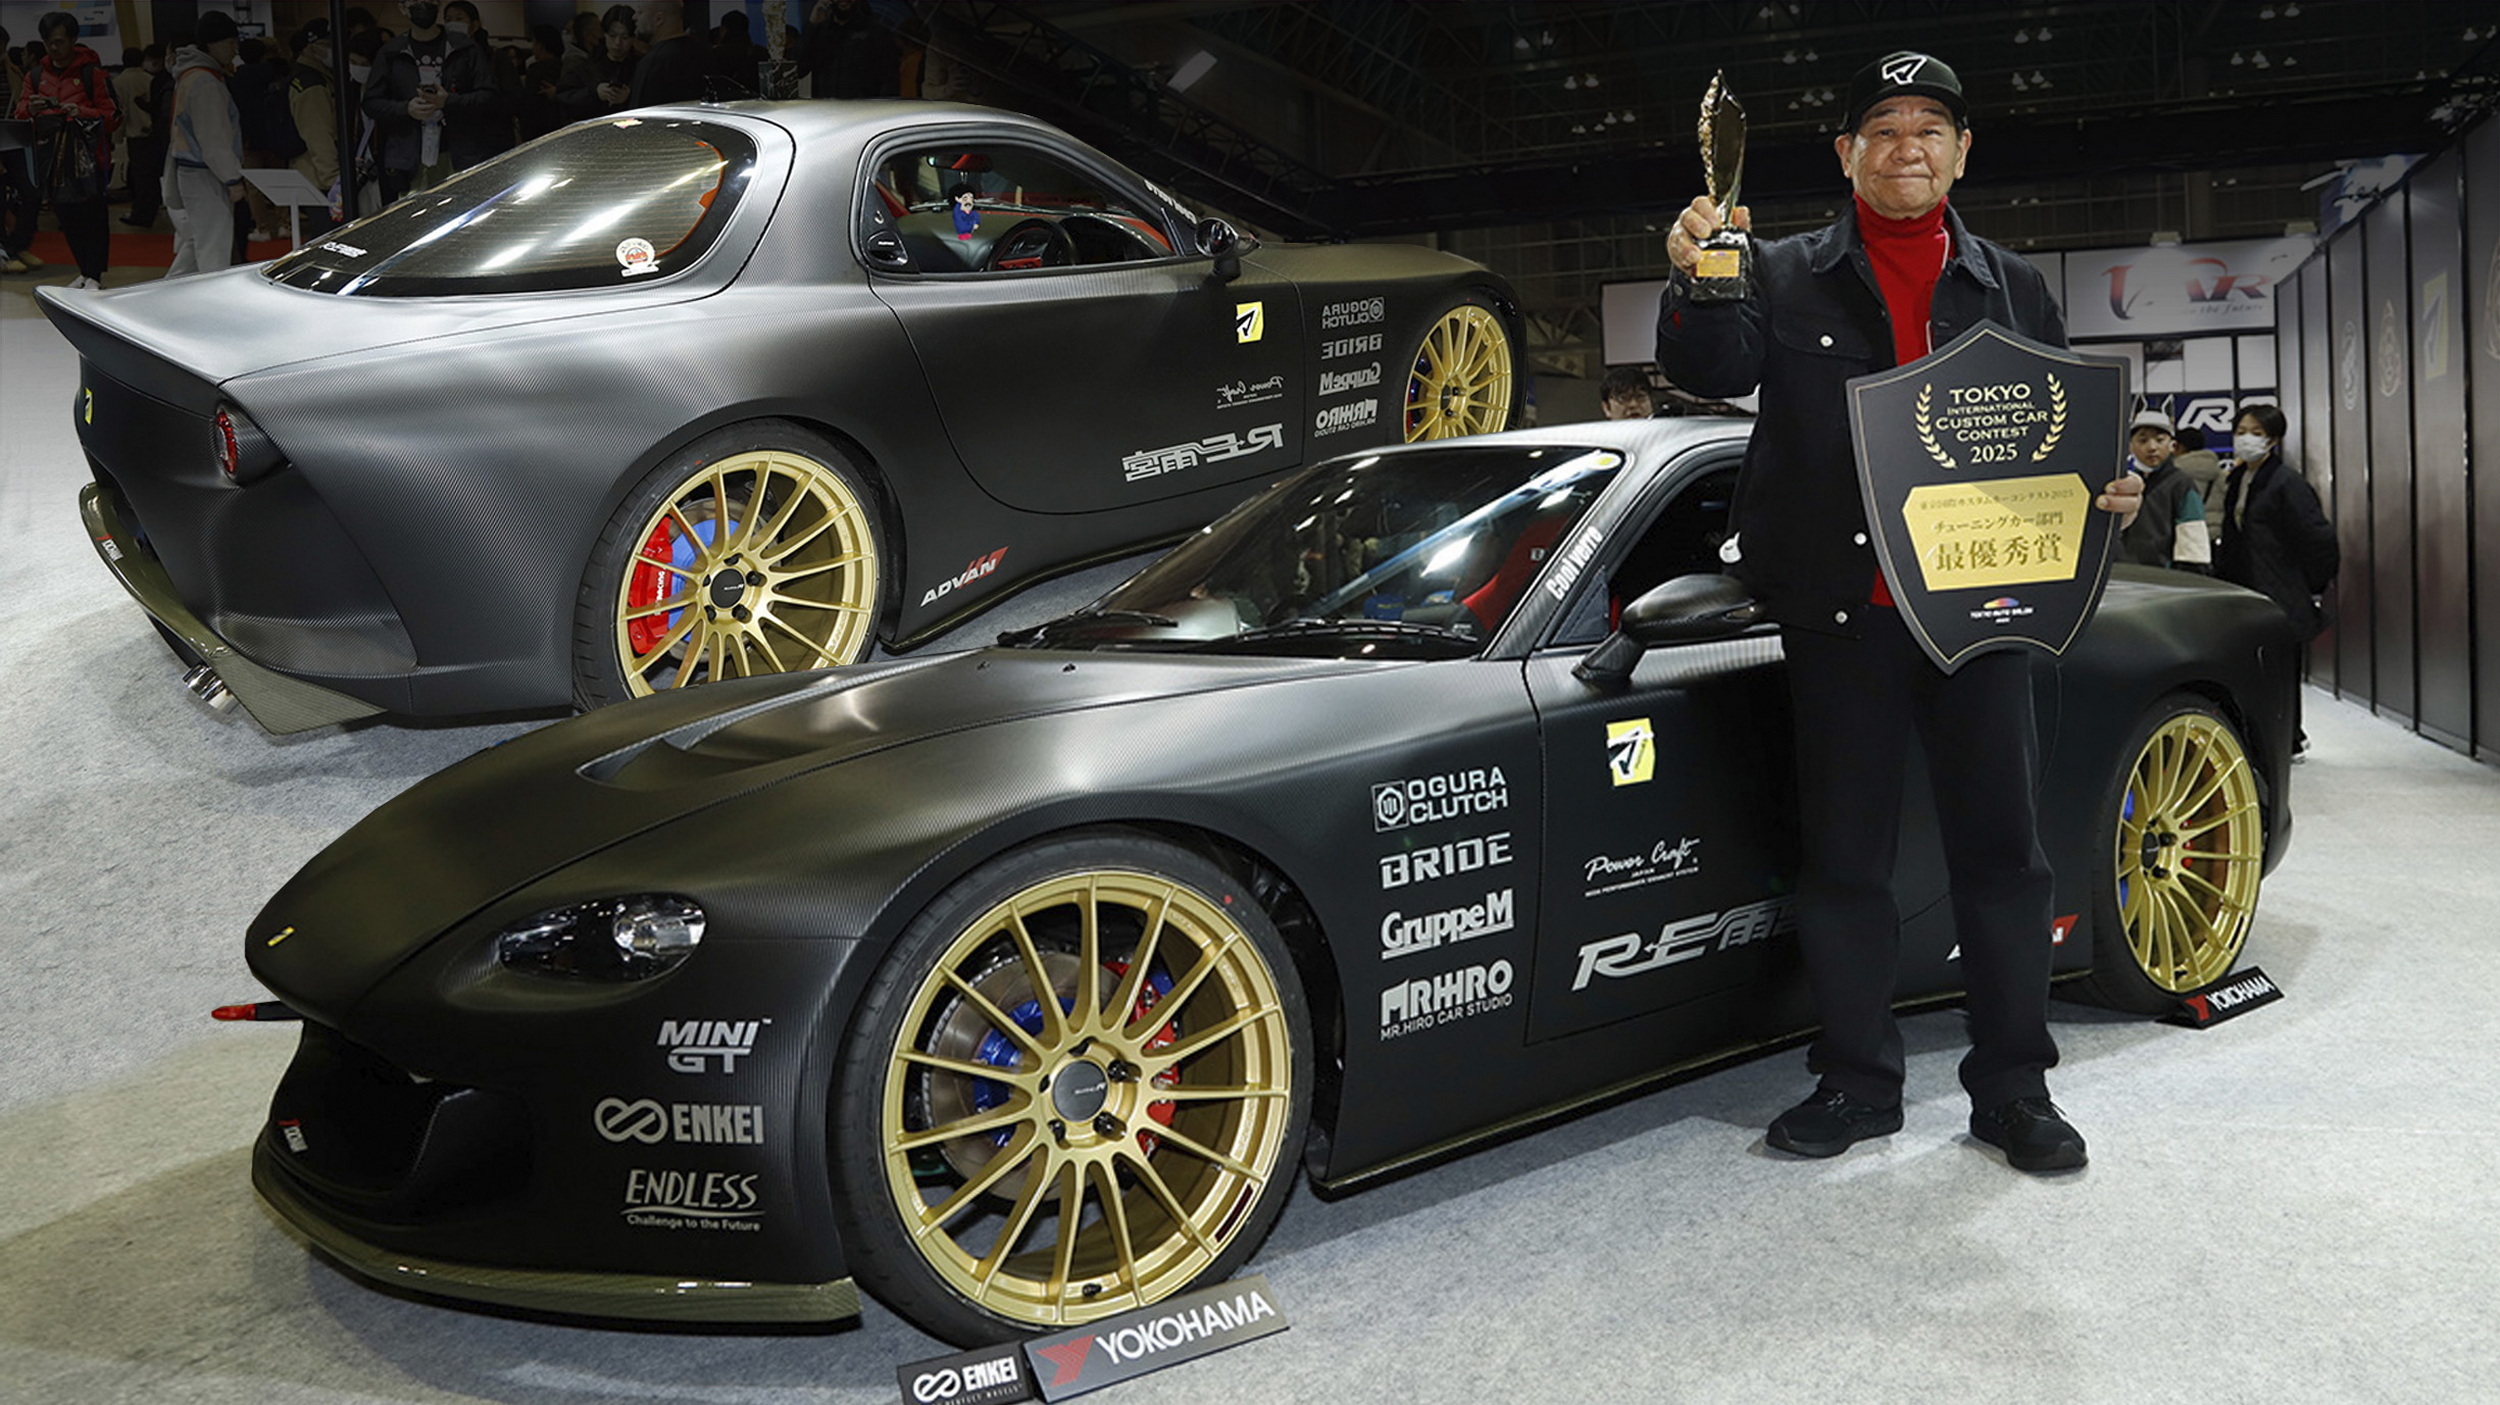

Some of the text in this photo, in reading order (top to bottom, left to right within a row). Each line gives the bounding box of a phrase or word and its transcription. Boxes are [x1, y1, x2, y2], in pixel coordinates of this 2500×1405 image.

[1946, 401, 2036, 416] INTERNATIONAL
[1949, 383, 2031, 404] TOKYO
[1935, 410, 2049, 431] CUSTOM CAR
[1956, 426, 2029, 442] CONTEST
[1970, 442, 2019, 464] 2025
[1934, 511, 2064, 534] チューニングカー部門
[1936, 533, 2063, 571] 最優秀賞
[920, 558, 997, 607] ADVAN
[1545, 557, 1580, 601] Cool
[1407, 766, 1507, 801] OGURA
[1409, 788, 1509, 824] CLUTCH
[1379, 832, 1513, 889] BRIDE
[1650, 837, 1700, 870] Craft
[1380, 888, 1515, 960] GruppeM
[657, 1020, 759, 1046] MINI
[1380, 992, 1513, 1042] MR.HIRO CAR STUDIO
[667, 1046, 752, 1074] GT
[672, 1104, 764, 1144] ENKEI
[625, 1169, 758, 1209] ENDLESS
[626, 1214, 761, 1232] Challenge to the Future
[1095, 1291, 1275, 1365] YOKOHAMA
[962, 1356, 1018, 1392] ENKEI
